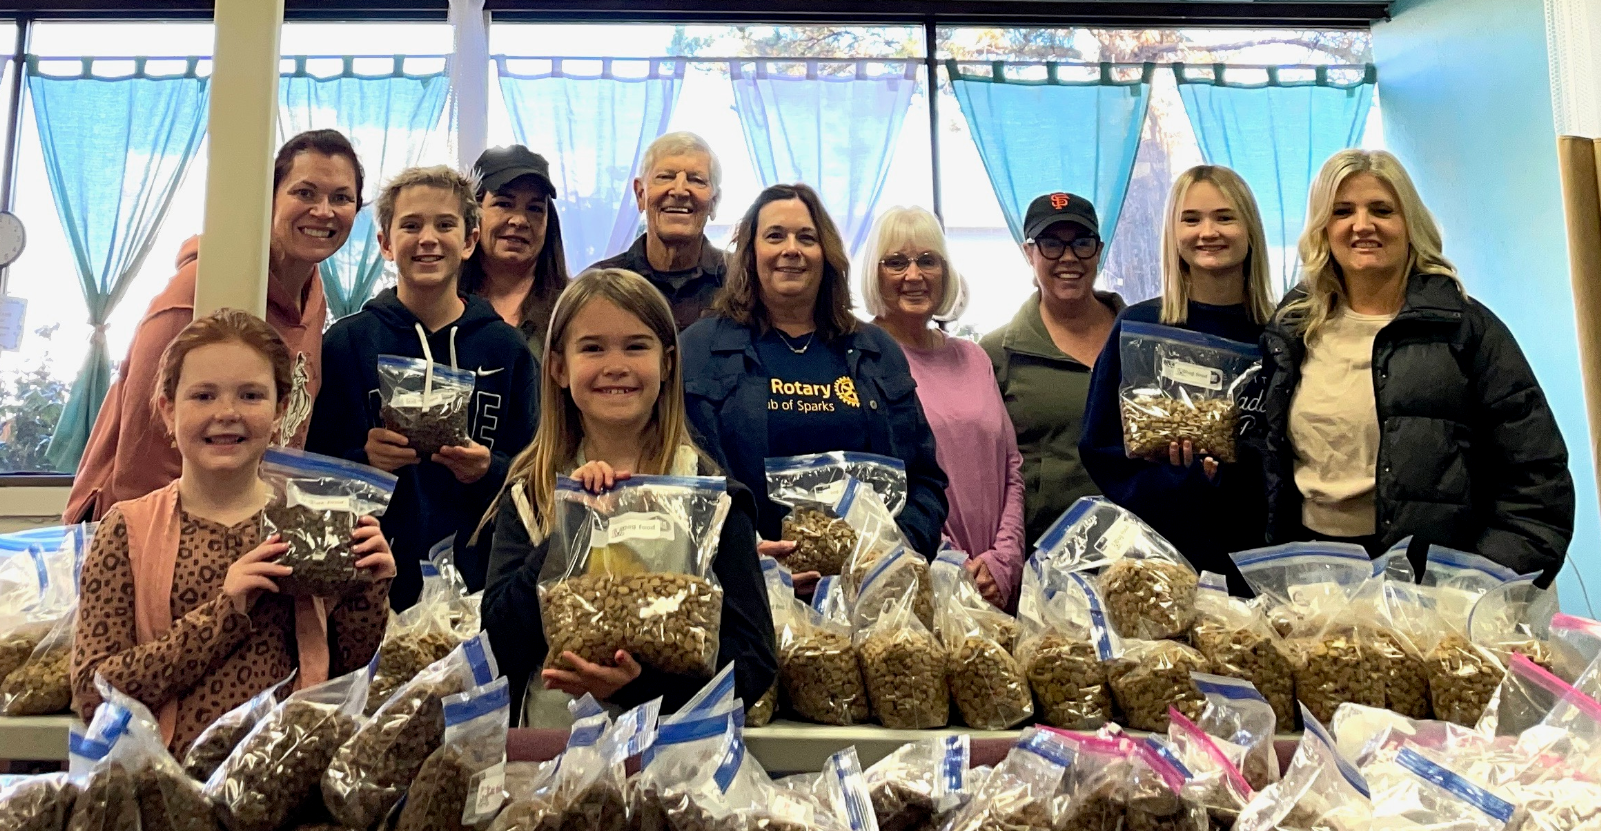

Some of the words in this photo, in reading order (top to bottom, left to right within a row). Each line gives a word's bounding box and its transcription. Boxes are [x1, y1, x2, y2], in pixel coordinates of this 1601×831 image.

[771, 378, 831, 399] Rotary
[781, 399, 794, 411] of
[797, 400, 835, 414] Sparks
